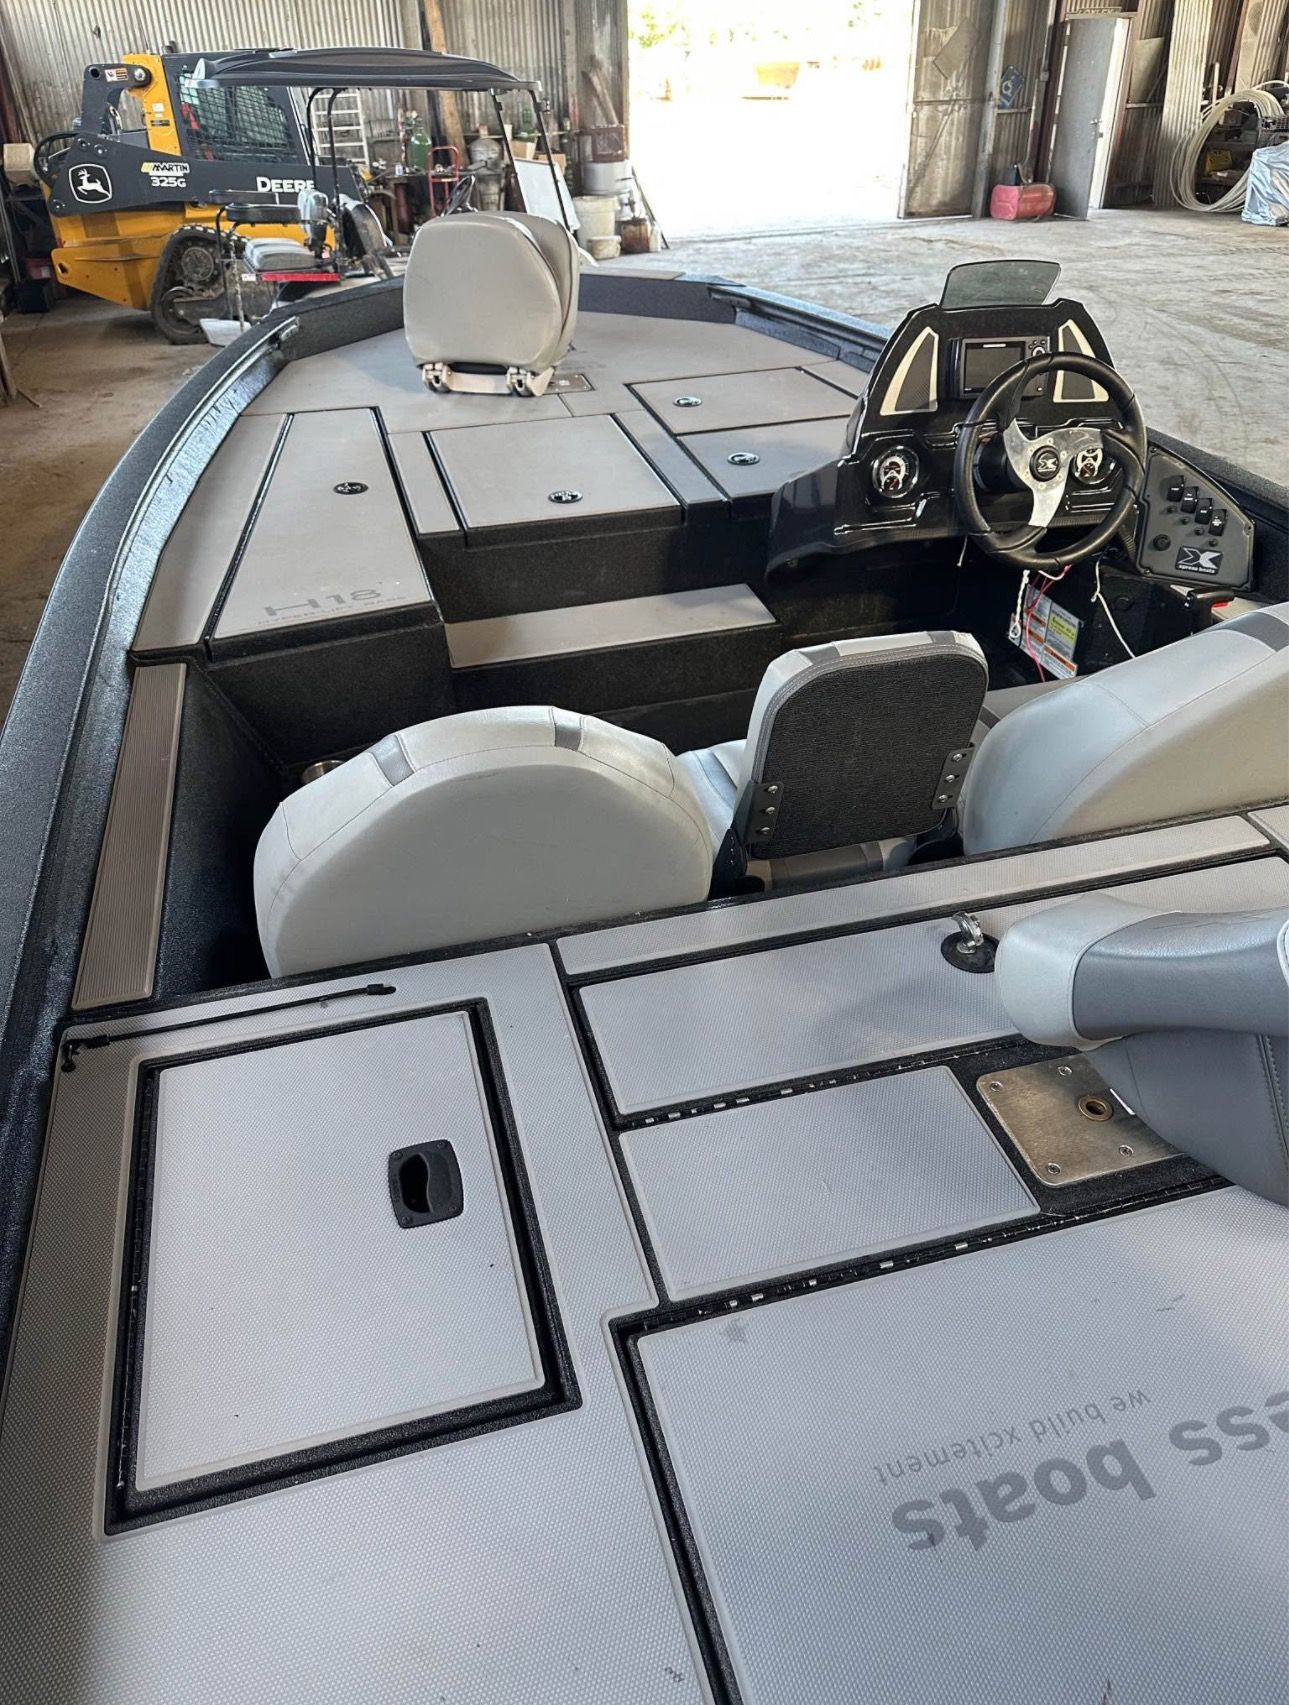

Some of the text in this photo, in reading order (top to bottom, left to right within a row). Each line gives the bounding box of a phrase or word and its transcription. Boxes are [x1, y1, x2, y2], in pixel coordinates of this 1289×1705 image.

[150, 177, 187, 188] 325G
[152, 163, 189, 172] MARTIN
[873, 1388, 1148, 1486] we build xcitement
[891, 1438, 1156, 1552] boats
